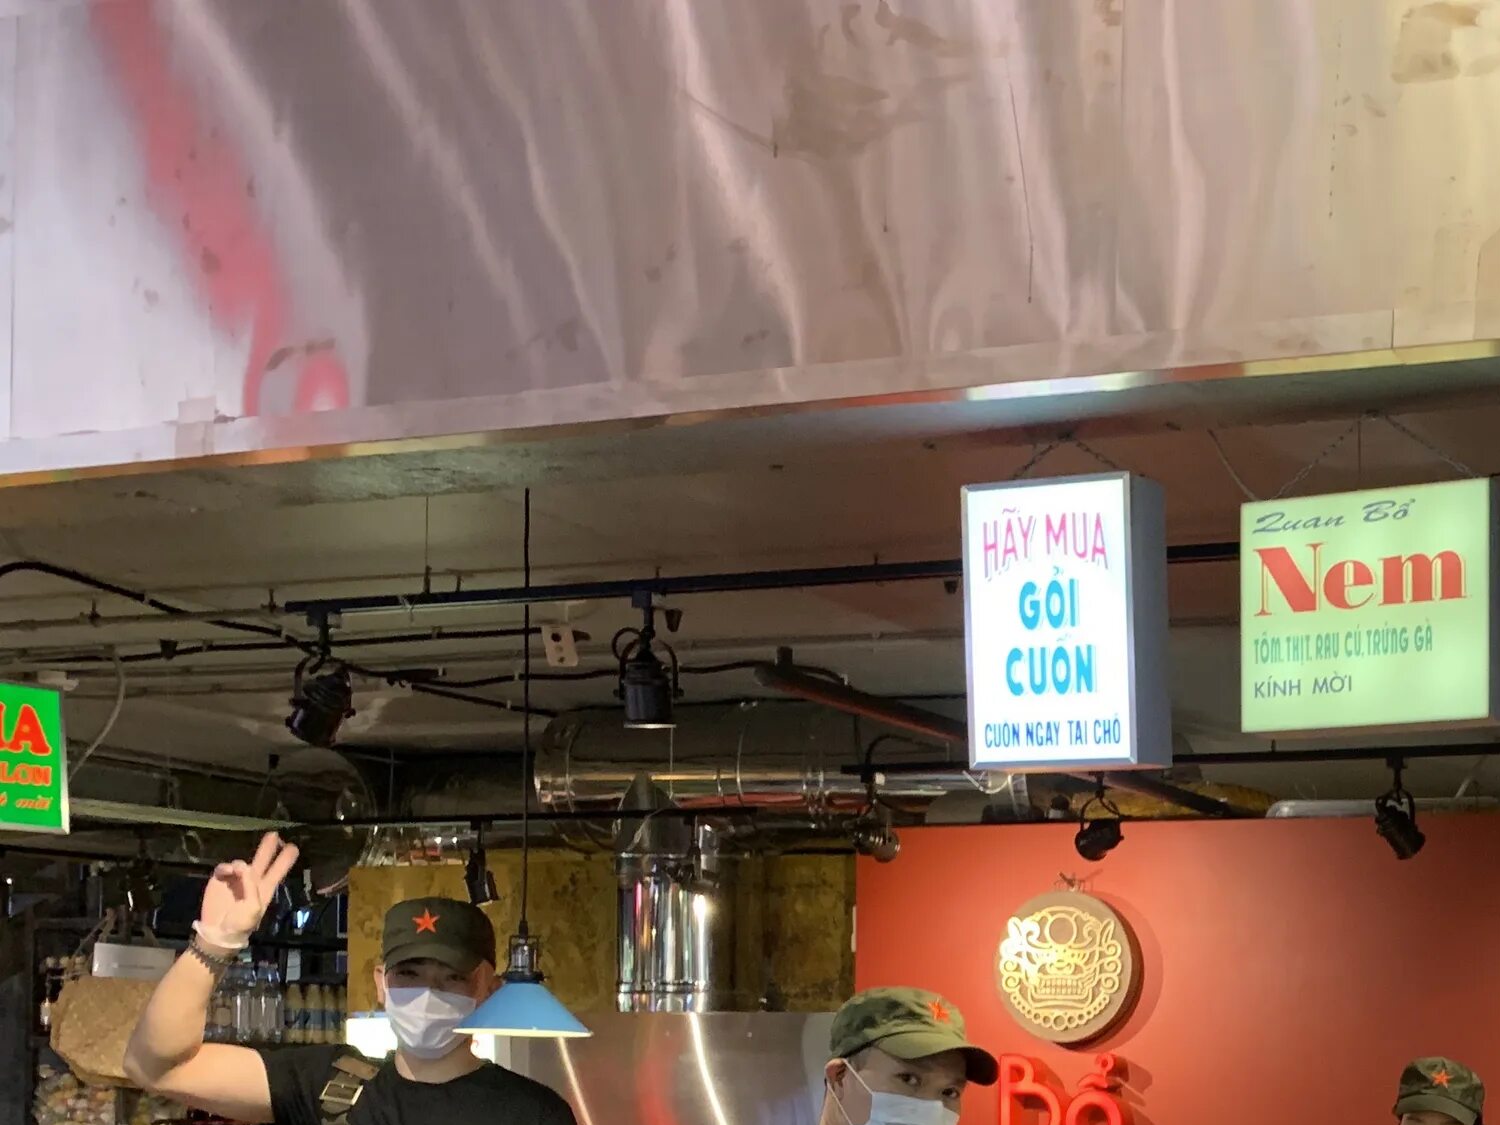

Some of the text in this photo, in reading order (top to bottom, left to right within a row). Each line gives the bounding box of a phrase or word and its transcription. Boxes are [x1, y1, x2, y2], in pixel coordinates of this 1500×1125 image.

[983, 507, 1109, 579] HÃY MUA
[1019, 566, 1078, 630] GỎI
[1253, 541, 1469, 617] Nem
[1315, 631, 1340, 661] RAU
[1254, 671, 1353, 700] KÍNH MỜI
[1026, 721, 1061, 748] NGAY
